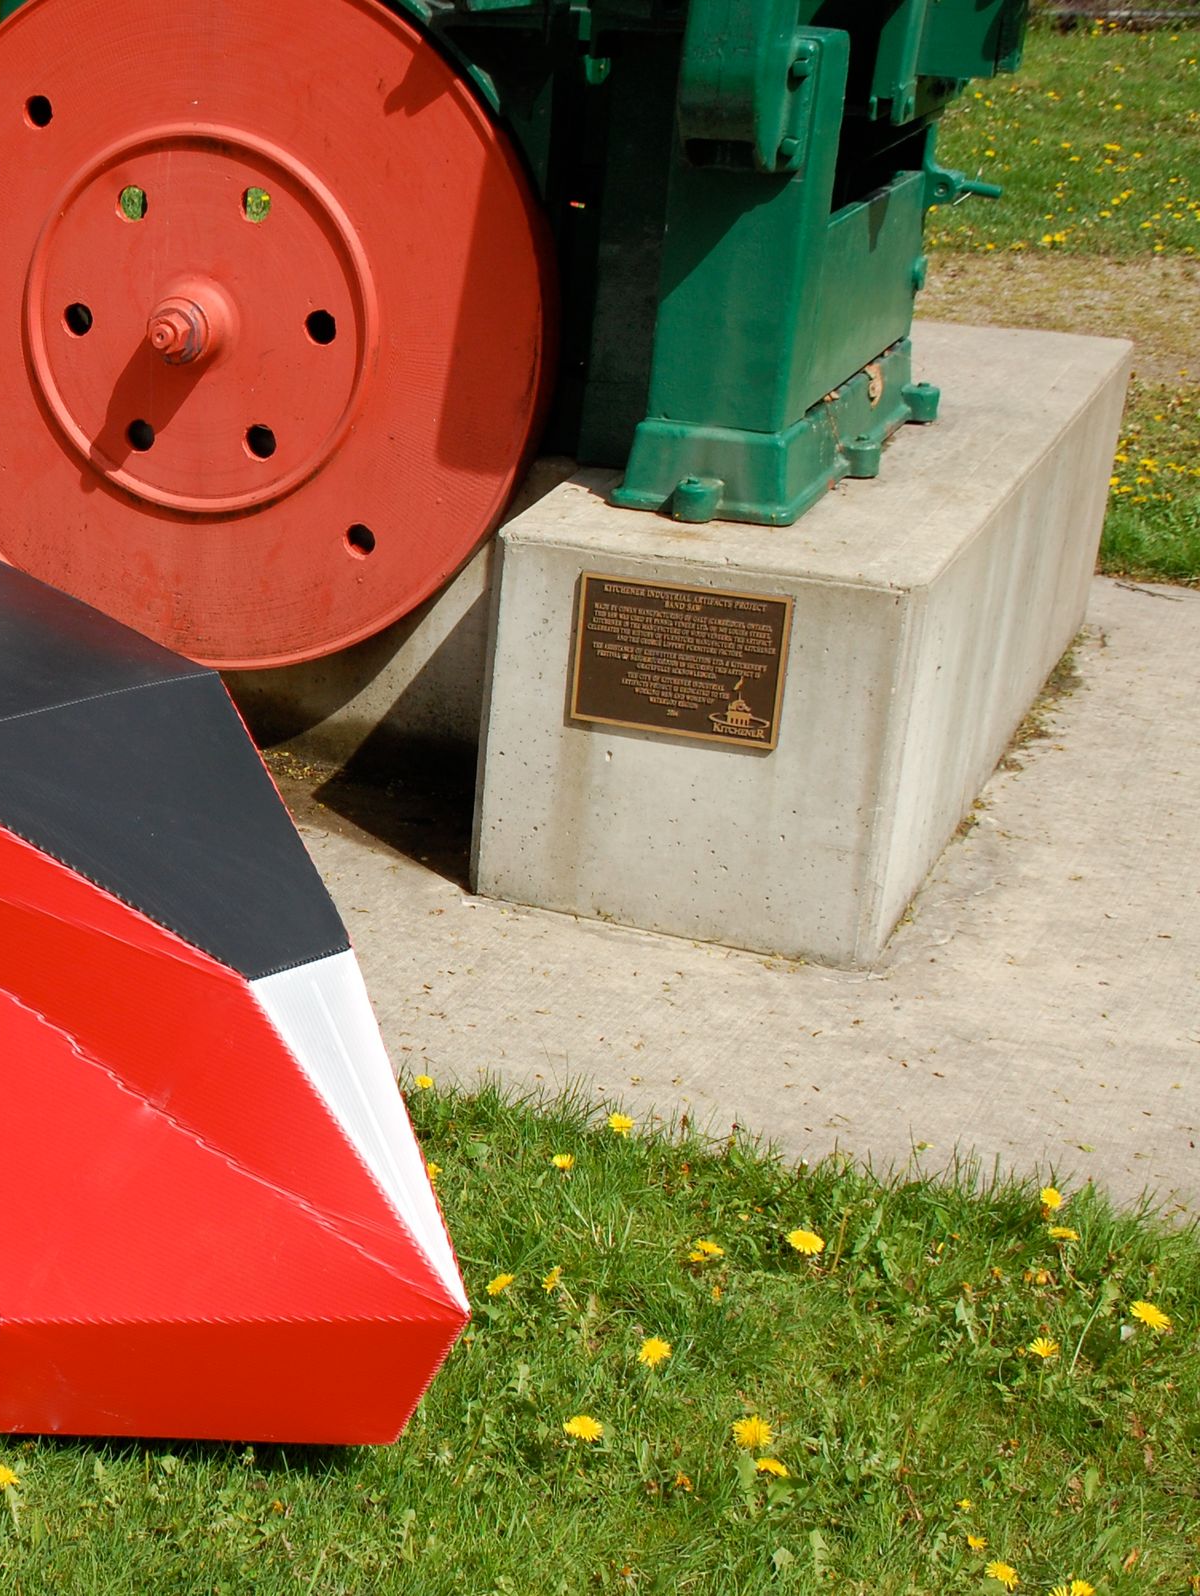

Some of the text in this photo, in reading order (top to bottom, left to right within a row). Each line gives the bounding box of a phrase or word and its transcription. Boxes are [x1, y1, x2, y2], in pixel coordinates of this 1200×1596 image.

[604, 584, 766, 611] KITCHENER INDUSTRIAL ARTIFACTS PROJECT
[664, 600, 700, 611] BAND SAW
[712, 722, 765, 737] KITCHENER
